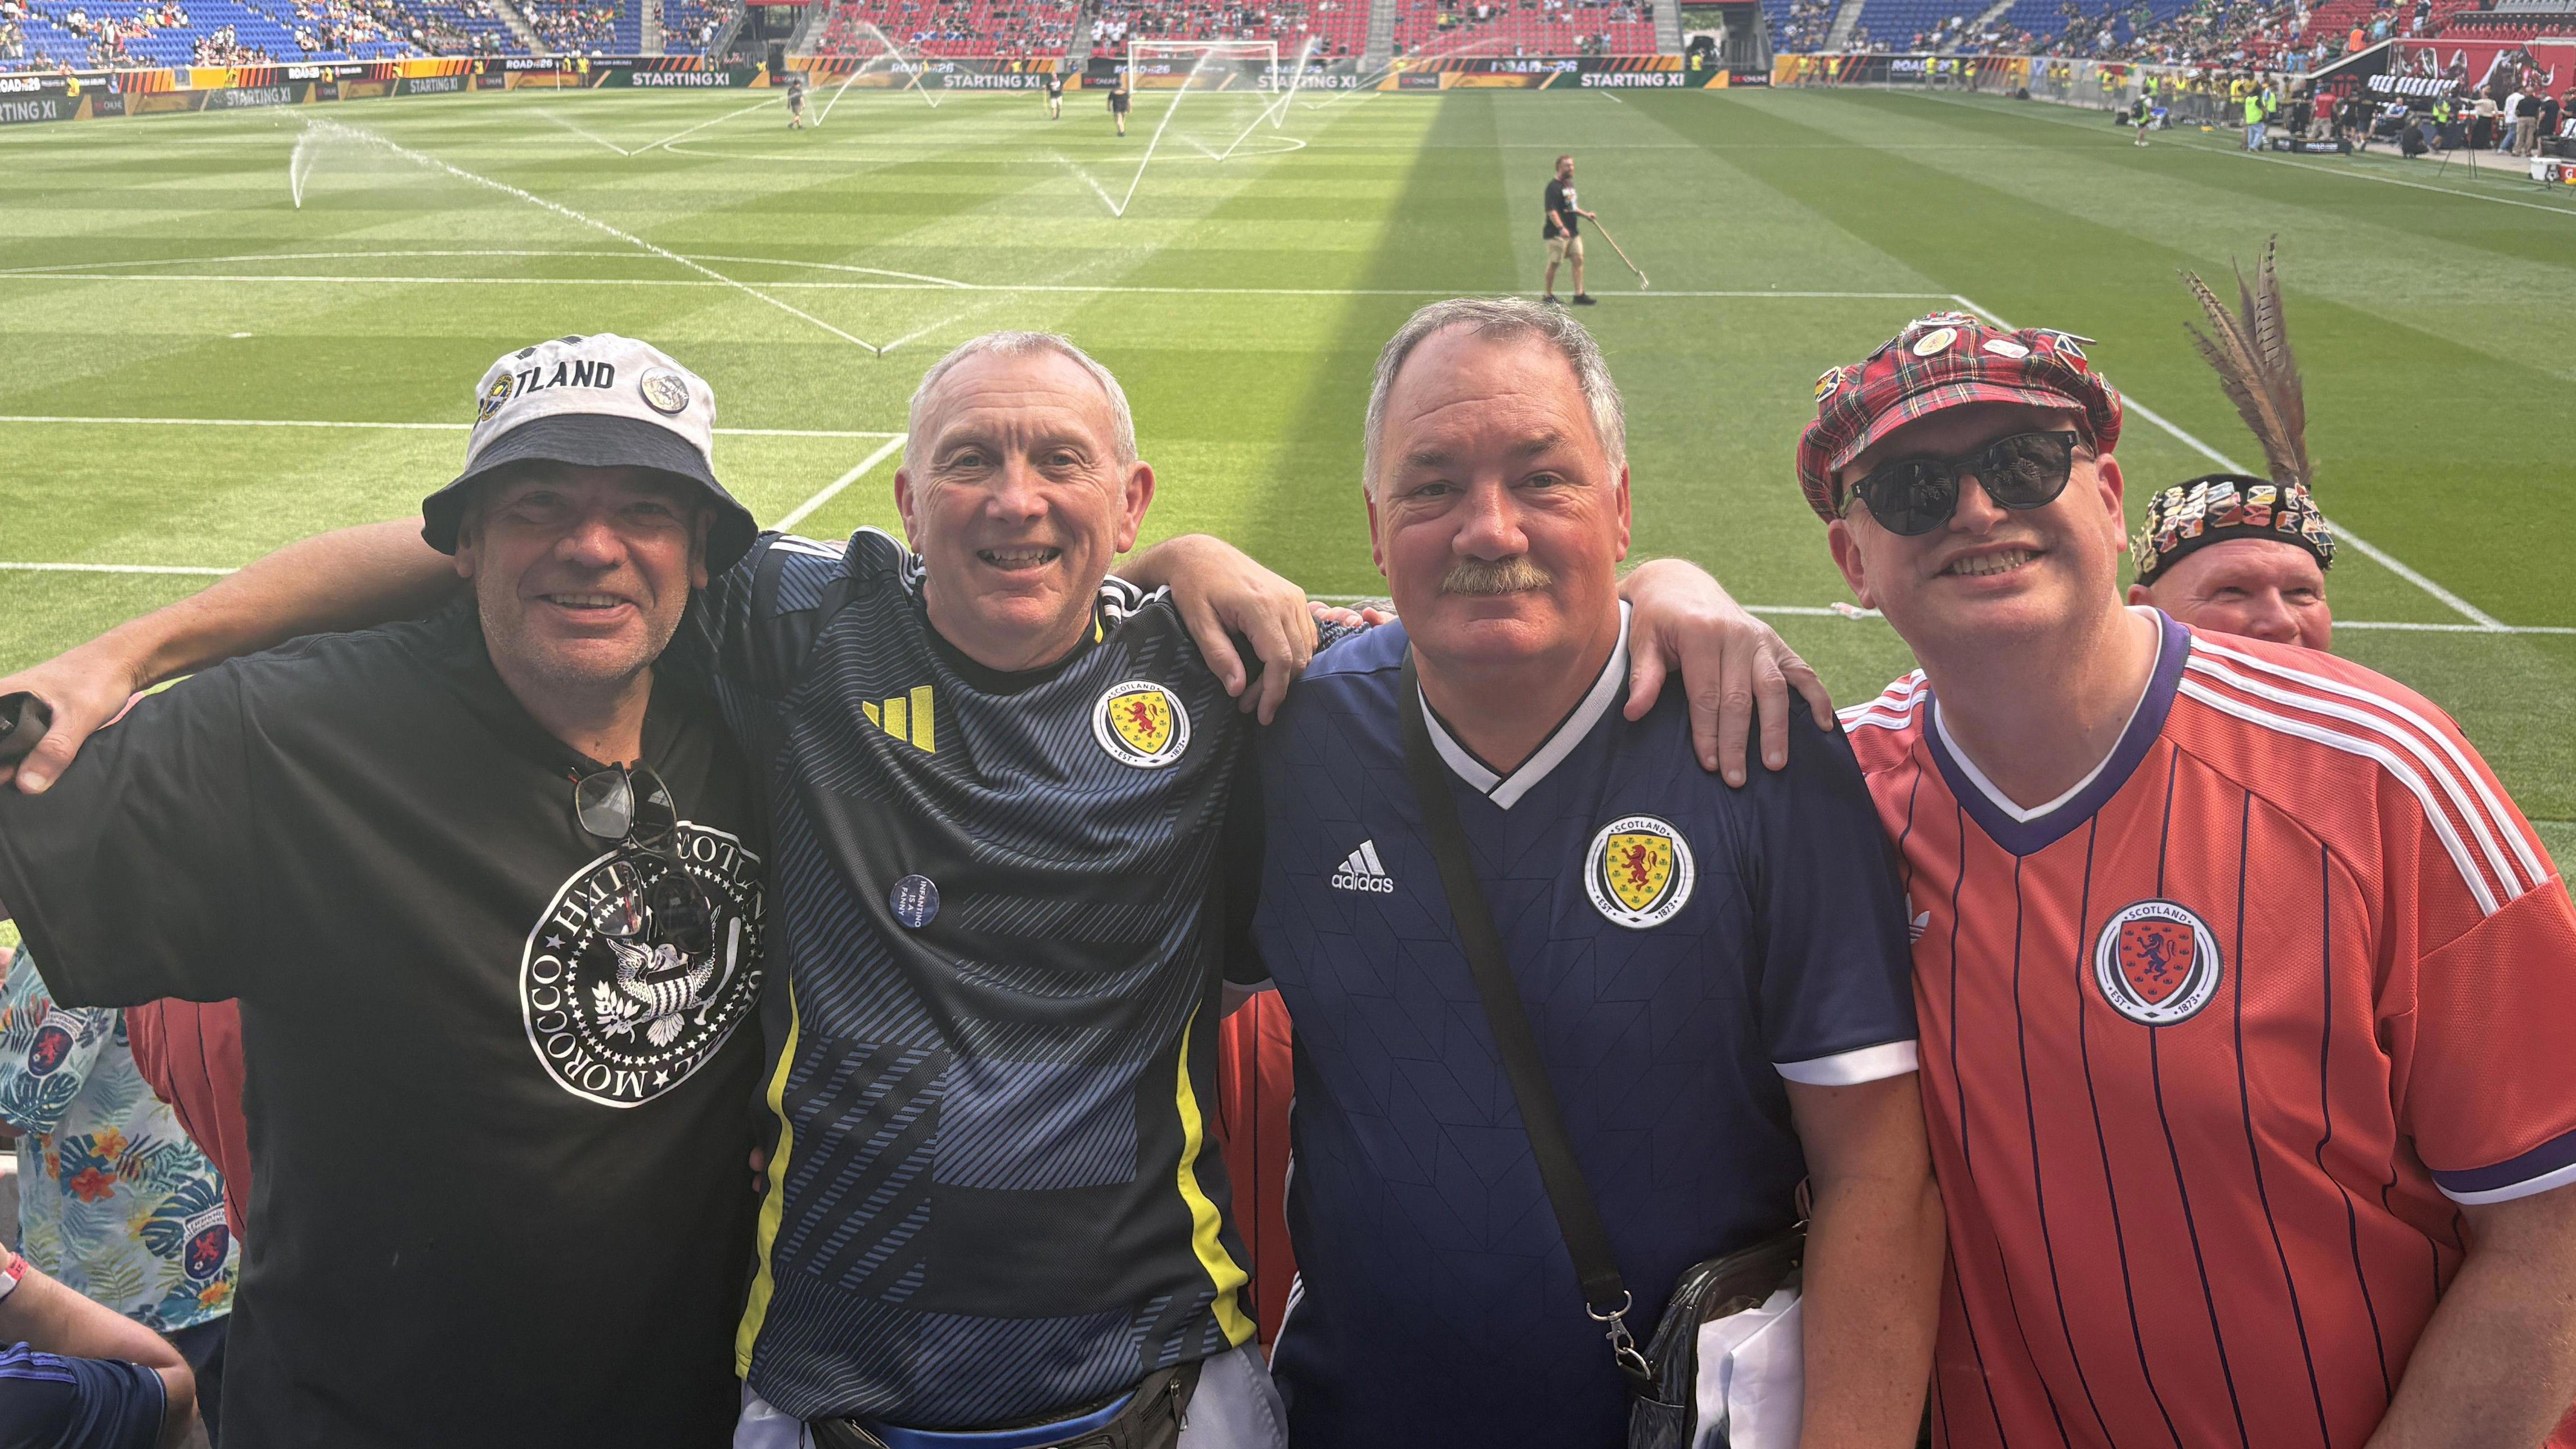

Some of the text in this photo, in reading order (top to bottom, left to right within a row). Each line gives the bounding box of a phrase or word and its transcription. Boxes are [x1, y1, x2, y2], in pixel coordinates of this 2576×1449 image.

[506, 60, 533, 69] ROAD
[891, 62, 925, 73] ROA
[1557, 60, 1578, 73] 26
[0, 78, 22, 93] OAD
[410, 77, 458, 93] STARTING XI
[632, 72, 729, 86] STARTING XI
[944, 74, 1041, 88] STARTING XI
[1341, 75, 1357, 88] XI
[1581, 73, 1685, 87] STARTING XI
[226, 86, 291, 106] STARTING XI
[0, 99, 56, 122] TING XI
[514, 359, 615, 399] TLAND
[1110, 683, 1156, 697] SCOTLAND
[1118, 742, 1185, 762] EST 1873
[1615, 820, 1667, 835] SCOTLAND
[1331, 872, 1394, 893] adidas
[898, 886, 908, 916] FANNY
[908, 894, 916, 903] IS
[915, 880, 927, 928] INFANTINO
[1598, 899, 1676, 918] EST 1873
[2128, 906, 2187, 922] SCOTLAND
[2110, 991, 2199, 1014] EST 1873
[532, 954, 649, 1099] MOROCCO
